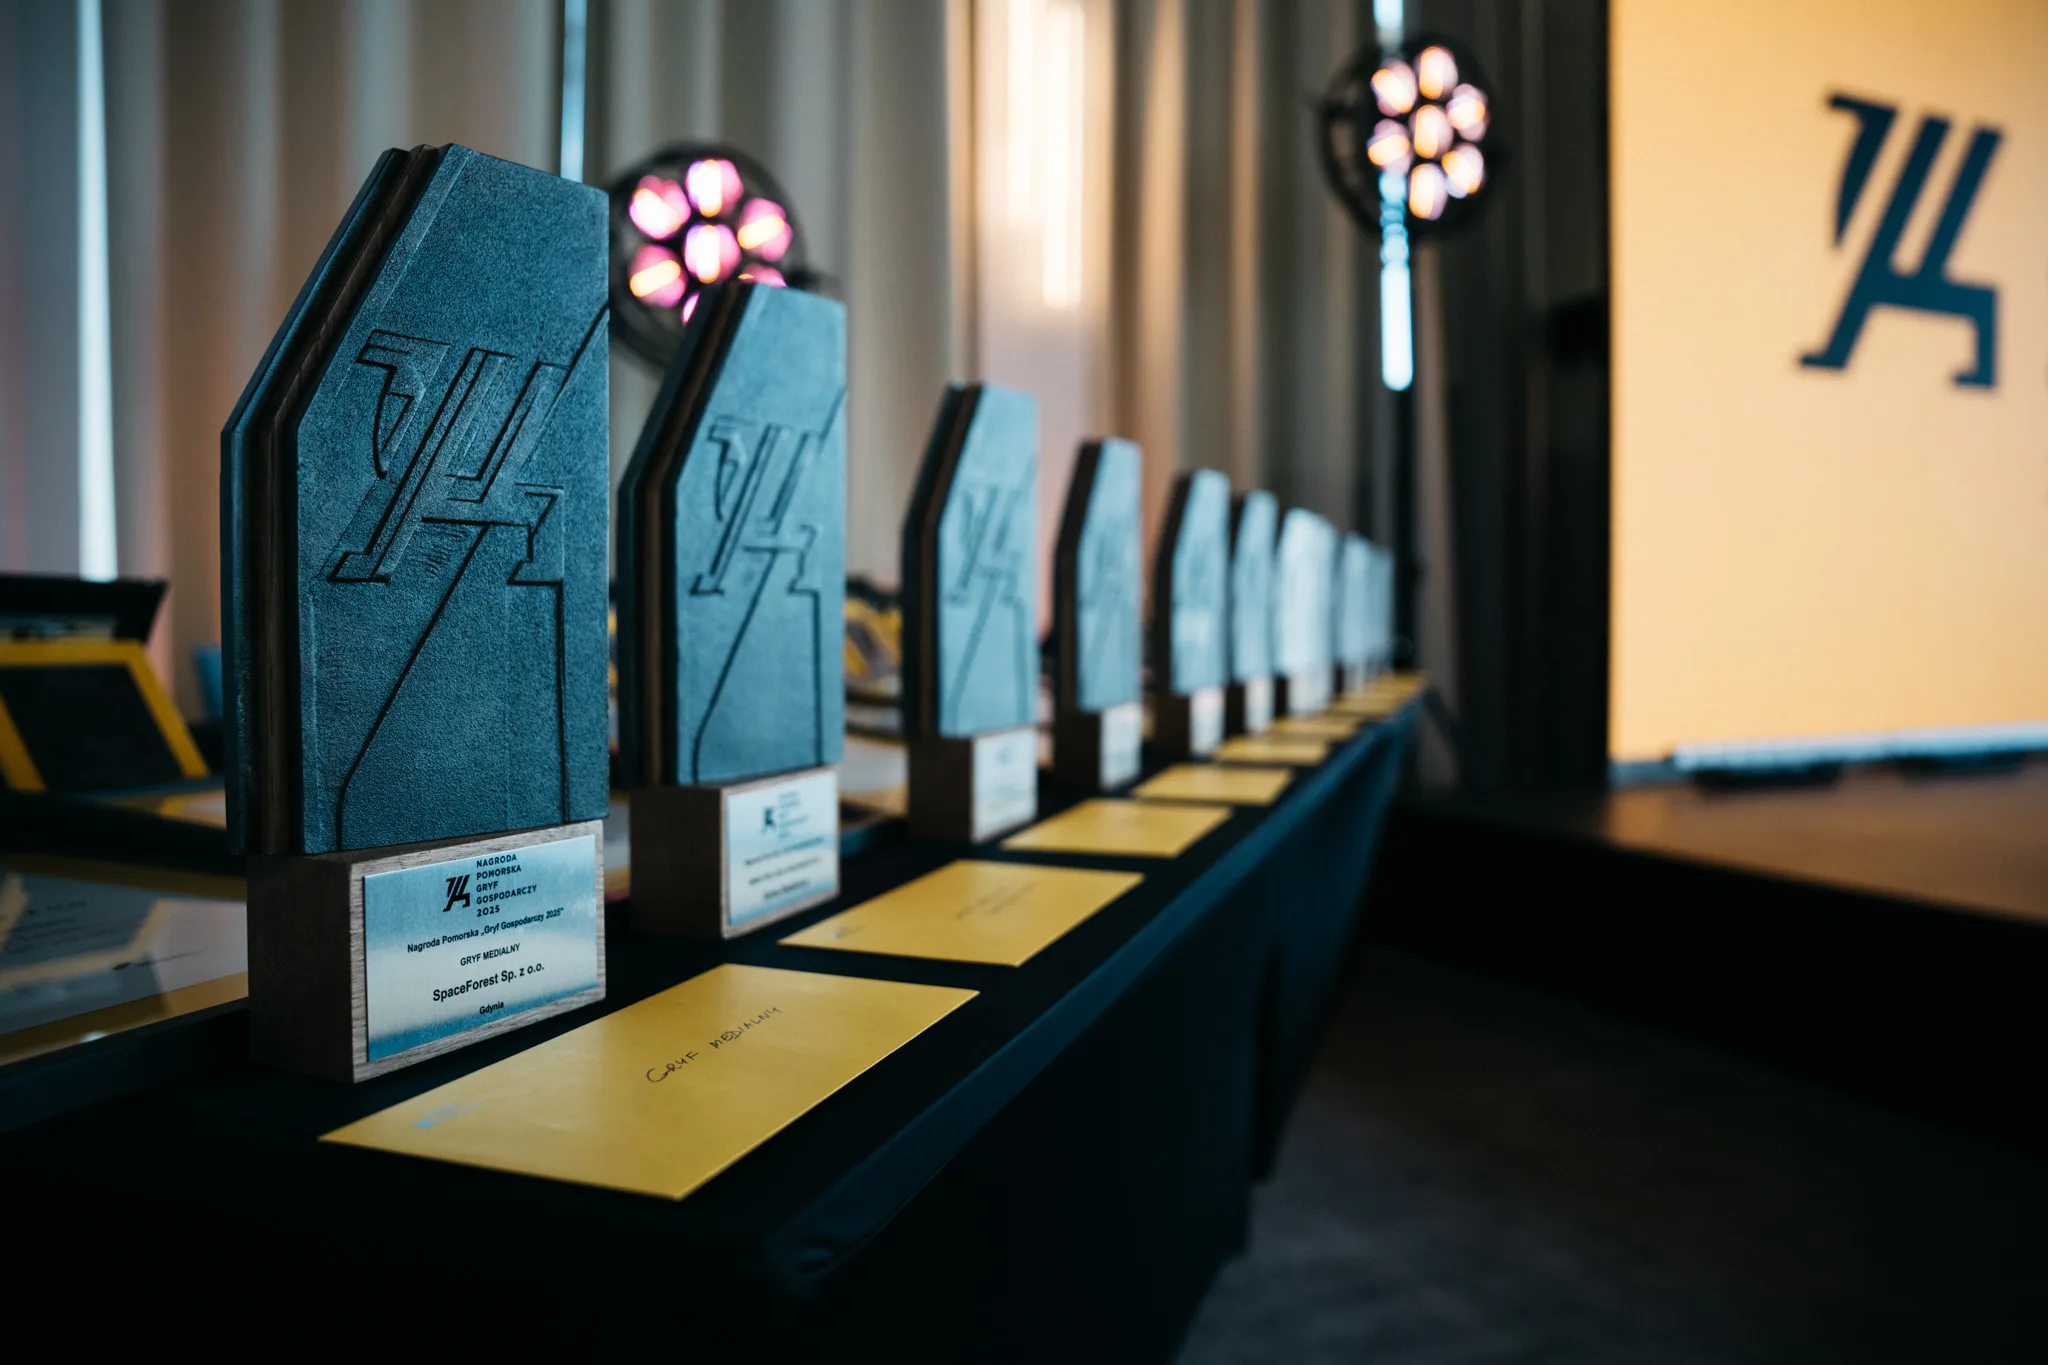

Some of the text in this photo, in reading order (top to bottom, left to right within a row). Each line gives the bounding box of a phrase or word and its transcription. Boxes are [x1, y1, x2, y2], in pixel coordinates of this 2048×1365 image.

[476, 853, 517, 868] NAGRODA
[476, 864, 522, 880] POMORSKA
[476, 881, 499, 893] GRYF
[476, 884, 537, 905] GOSPODARCZY
[477, 905, 500, 917] 2025
[407, 938, 441, 954] Nagroda
[442, 929, 479, 945] Pomorska
[501, 913, 545, 930] Gospodarczy
[460, 943, 521, 966] GRYF MEDIALNY
[432, 963, 545, 1003] SpaceForest Sp. z o.o.
[479, 1001, 504, 1016] Gdynia
[646, 1051, 699, 1083] GRYF
